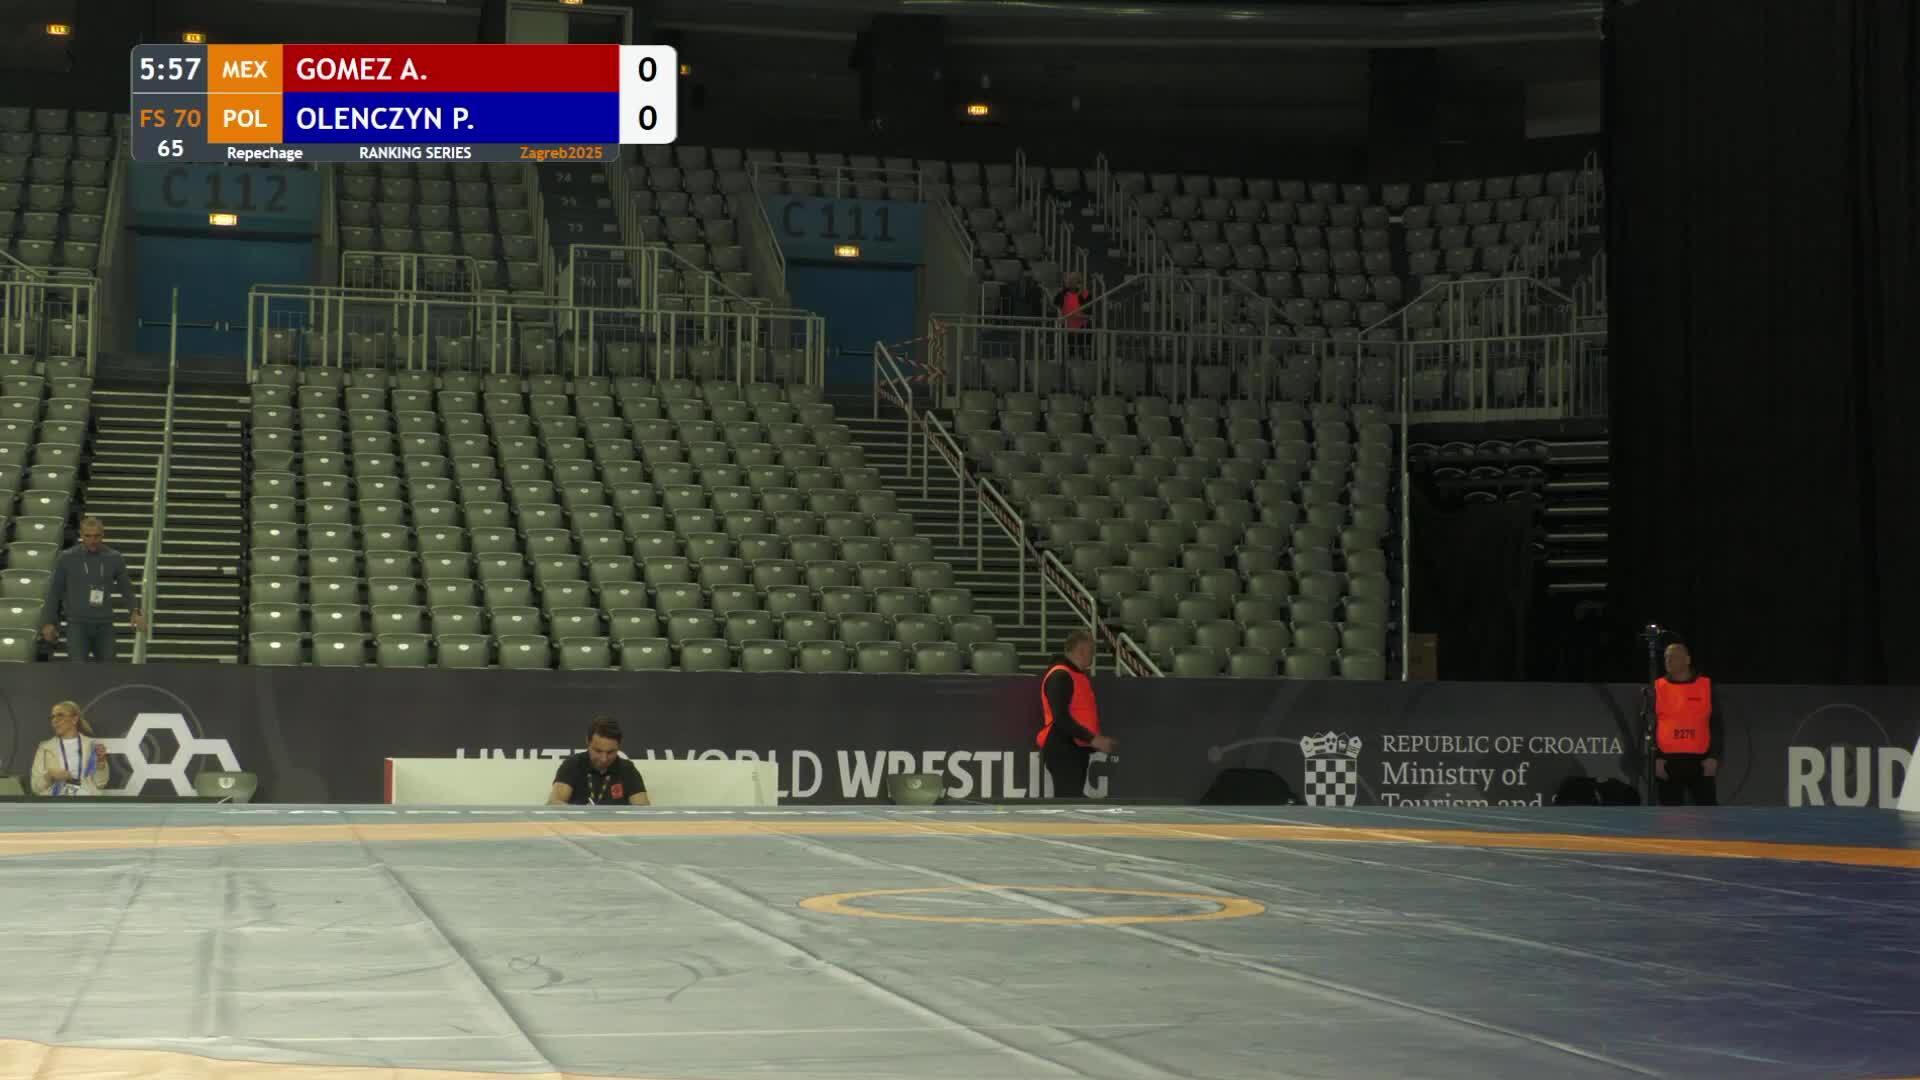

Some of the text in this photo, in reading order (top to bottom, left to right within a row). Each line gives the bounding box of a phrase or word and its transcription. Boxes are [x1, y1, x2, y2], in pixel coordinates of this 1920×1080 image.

[162, 166, 289, 212] C 112
[782, 201, 896, 241] C 111
[1382, 735, 1624, 754] REPUBLIC OF CROATIA
[837, 750, 1109, 799] WRESTLIG
[1382, 762, 1530, 791] Ministry of
